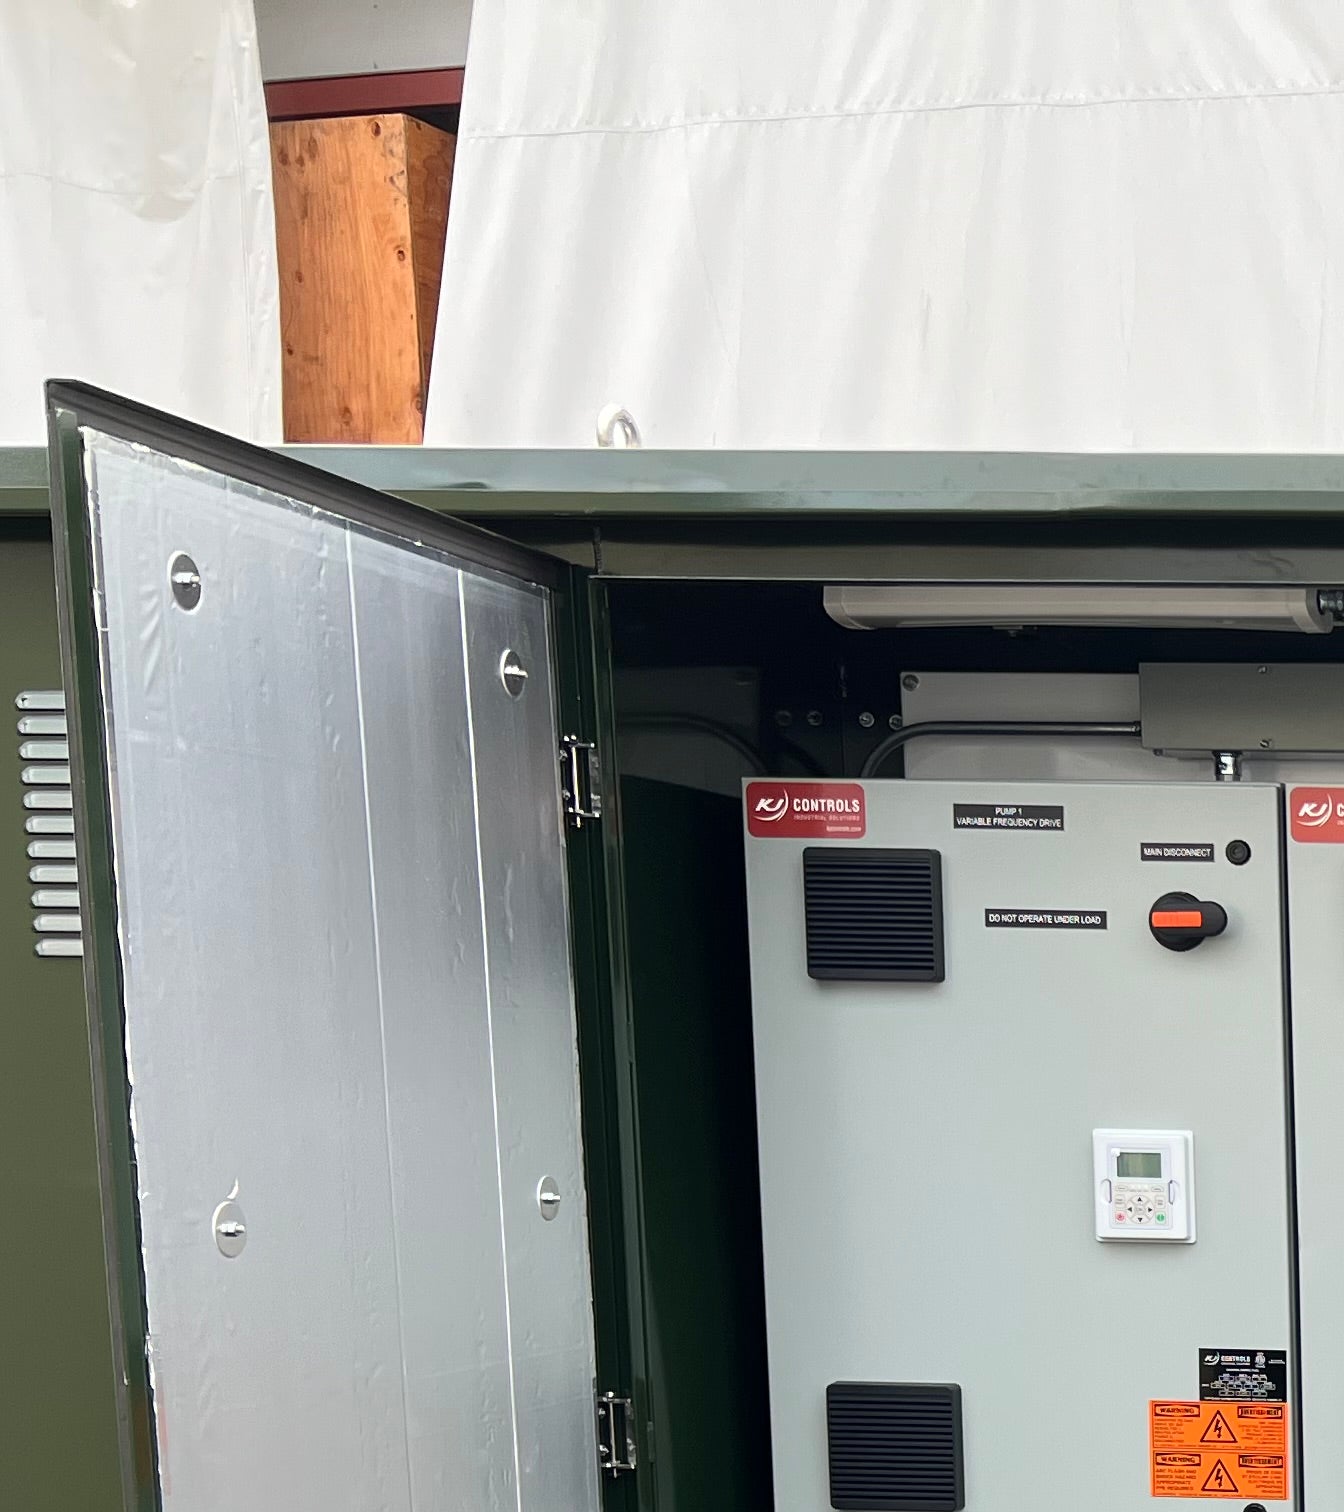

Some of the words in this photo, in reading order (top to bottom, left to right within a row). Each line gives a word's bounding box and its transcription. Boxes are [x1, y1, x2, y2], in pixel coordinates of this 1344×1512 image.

[793, 798, 860, 813] CONTROLS
[995, 807, 1016, 816] PUMP
[956, 817, 992, 826] VARIABLE
[993, 818, 1038, 827] FREQUENCY
[1039, 819, 1061, 828] DRIVE
[1143, 847, 1162, 856] MAIN
[1163, 848, 1211, 857] DISCONNECT
[989, 914, 1000, 922] DO
[1001, 914, 1017, 923] NOT
[1018, 914, 1053, 924] OPERATE
[1054, 915, 1080, 924] UNDER
[1080, 916, 1101, 924] LOAD
